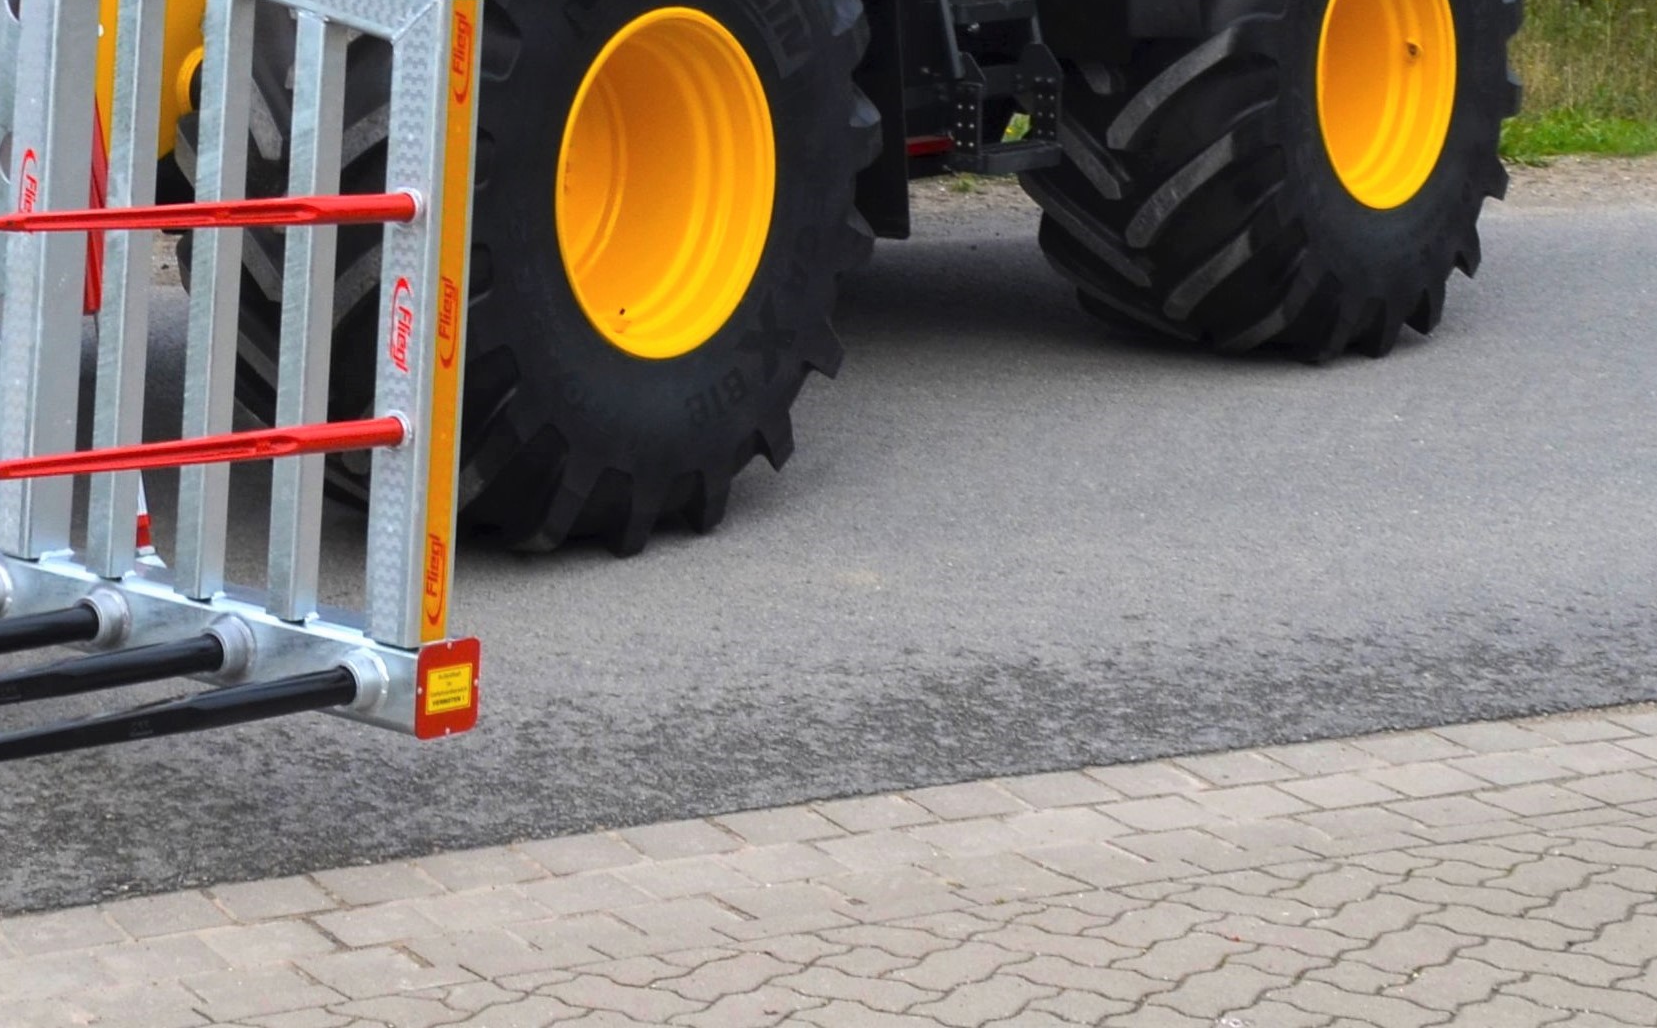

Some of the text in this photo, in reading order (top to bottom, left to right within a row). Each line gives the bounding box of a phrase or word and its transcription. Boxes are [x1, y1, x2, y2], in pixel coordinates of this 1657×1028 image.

[452, 10, 474, 75] Fliegl
[392, 305, 413, 373] Fliegl
[438, 275, 460, 341] Fliegl
[426, 532, 447, 598] Fliegl
